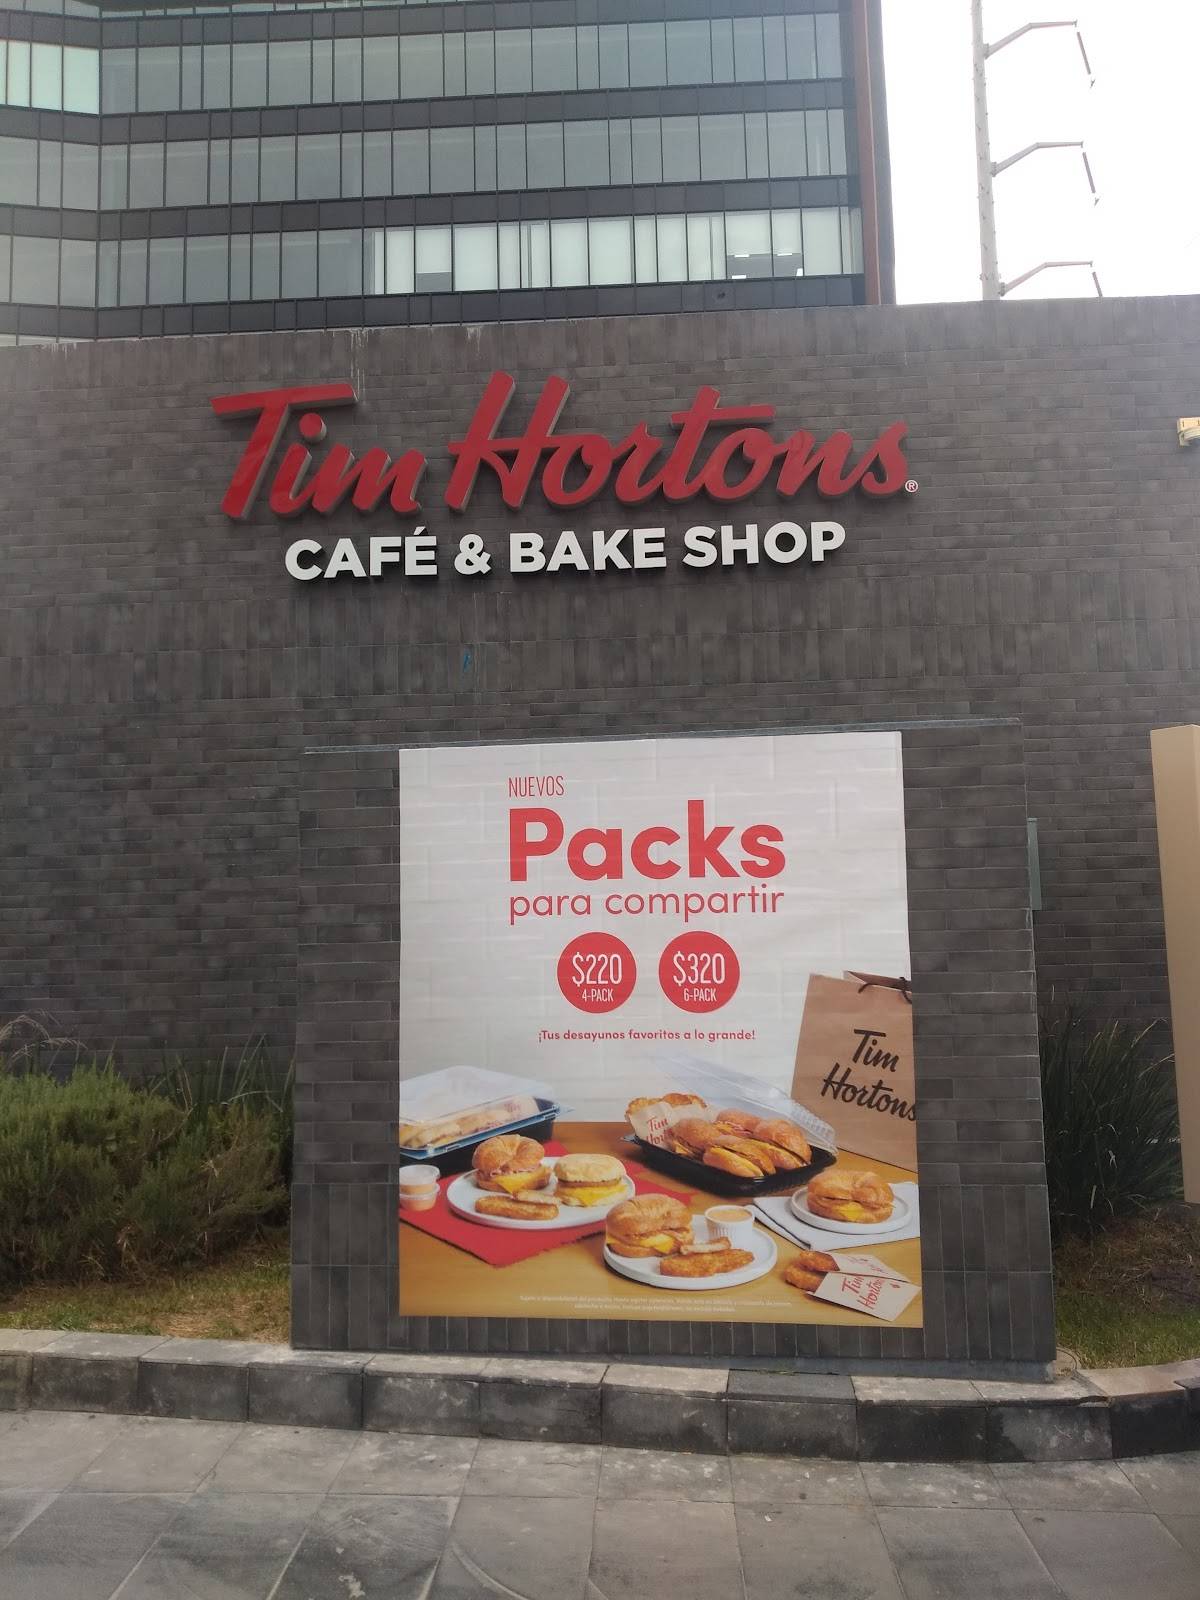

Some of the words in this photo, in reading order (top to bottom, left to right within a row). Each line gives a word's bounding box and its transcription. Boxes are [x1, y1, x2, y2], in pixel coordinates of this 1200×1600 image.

[211, 382, 427, 519] Tim
[444, 371, 908, 510] Hortons
[285, 526, 438, 581] CAFÉ
[454, 533, 491, 575] &
[509, 527, 667, 573] BAKE
[682, 521, 846, 568] SHOP
[507, 775, 565, 798] NUEVOS
[508, 799, 787, 882] Packs
[509, 894, 592, 926] para
[604, 882, 785, 923] compartir
[571, 951, 623, 987] $220
[672, 950, 726, 987] $320
[581, 988, 614, 1002] 4-PACK
[683, 988, 717, 1002] 6-PACK
[538, 1029, 560, 1042] ¡Tus
[563, 1029, 626, 1044] desayunos
[628, 1028, 682, 1041] favoritos
[684, 1031, 692, 1041] a
[694, 1029, 705, 1041] lo
[708, 1029, 756, 1043] grande!
[852, 1028, 900, 1073] Tim
[821, 1062, 918, 1122] Hortons
